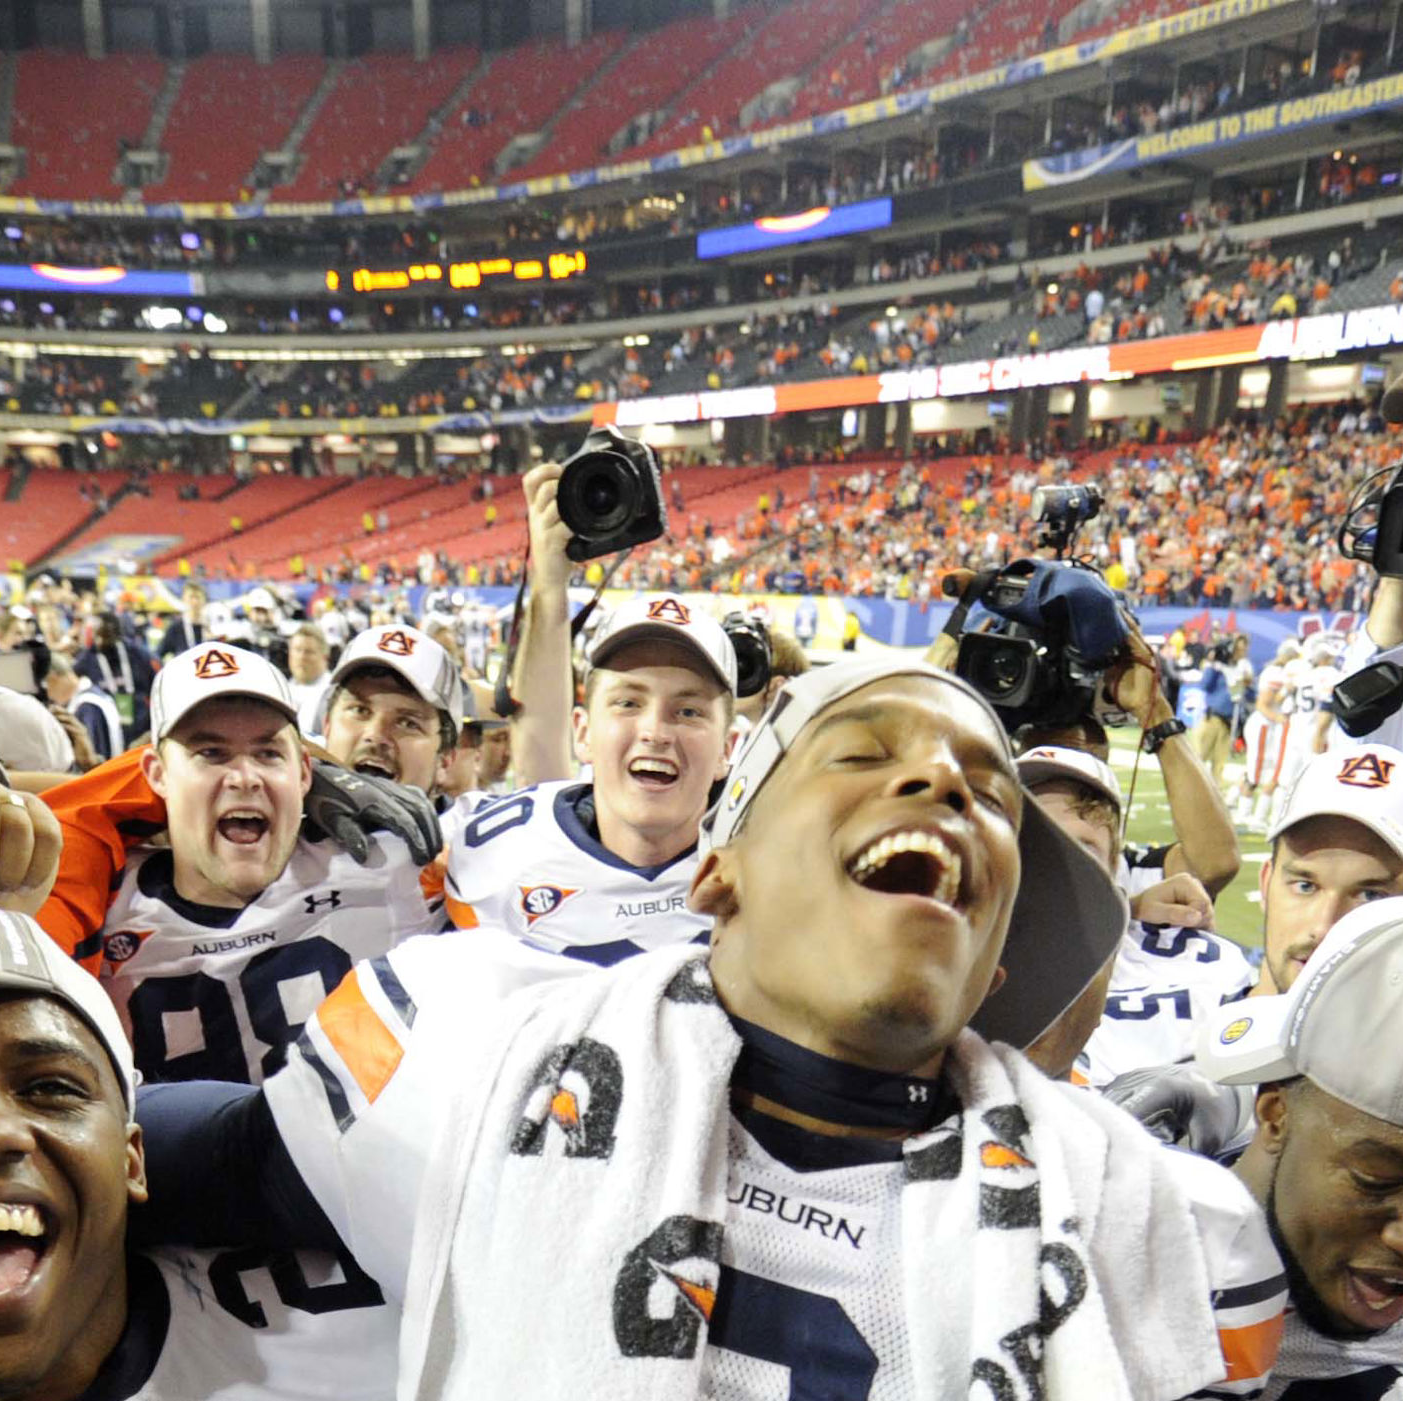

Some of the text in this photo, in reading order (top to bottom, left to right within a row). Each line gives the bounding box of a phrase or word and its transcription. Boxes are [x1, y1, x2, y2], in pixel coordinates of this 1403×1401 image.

[1137, 120, 1215, 158] WELCOME
[1220, 115, 1242, 139] TO
[1245, 105, 1279, 133] THE
[615, 897, 685, 918] AUBUR
[191, 931, 277, 956] AUBURN
[726, 1181, 867, 1250] UBURN
